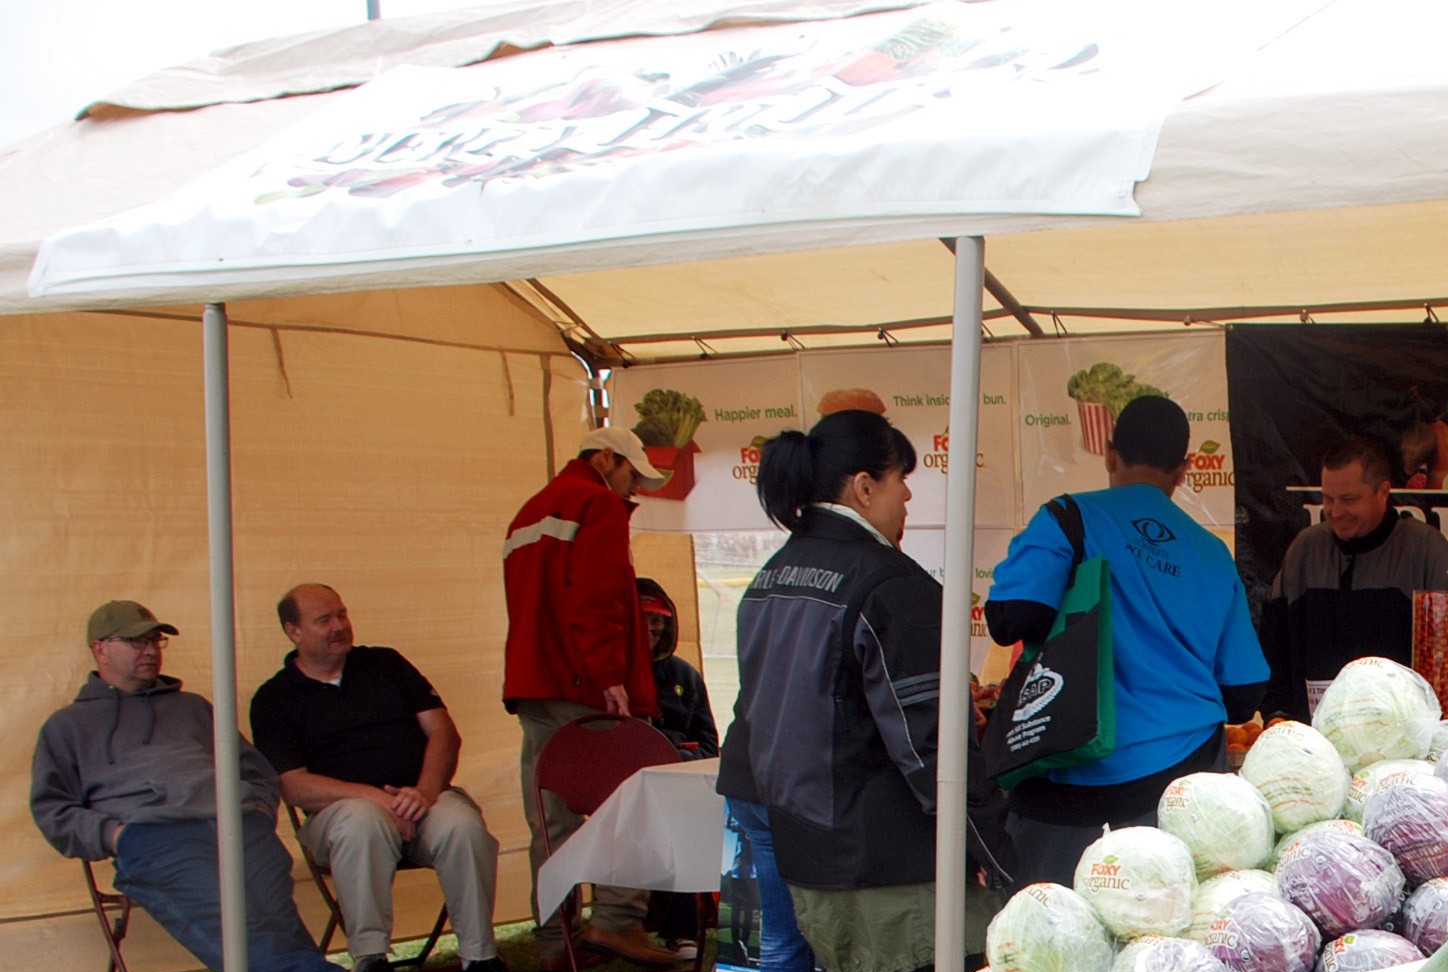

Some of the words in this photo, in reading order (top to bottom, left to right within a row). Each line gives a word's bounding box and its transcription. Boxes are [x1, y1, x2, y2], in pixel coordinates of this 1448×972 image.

[893, 395, 922, 406] Think
[983, 394, 1006, 405] bun.
[715, 406, 762, 422] Happier
[765, 404, 798, 419] meal.
[1025, 414, 1072, 428] Original.
[1187, 453, 1225, 470] FOXY
[1187, 471, 1235, 493] rganic
[1091, 863, 1121, 876] FOXY
